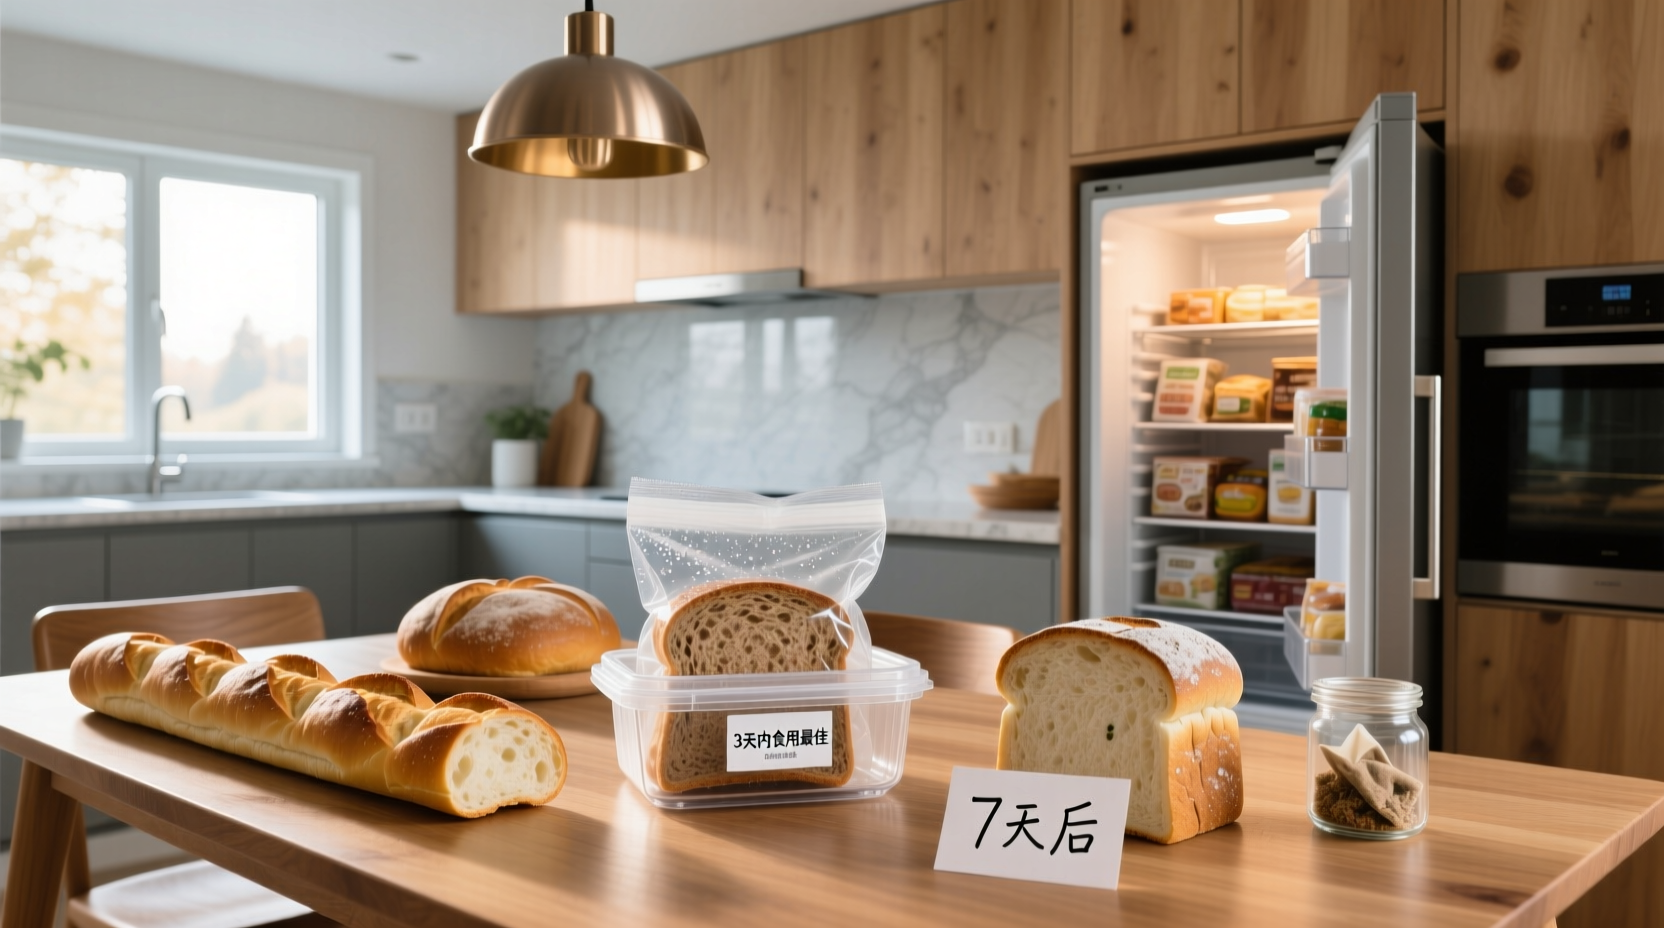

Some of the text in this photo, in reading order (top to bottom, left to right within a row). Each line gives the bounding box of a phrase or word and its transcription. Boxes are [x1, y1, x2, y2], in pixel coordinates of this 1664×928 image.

[733, 727, 829, 750] 3天内食用最佳
[972, 796, 1098, 856] 7天后
